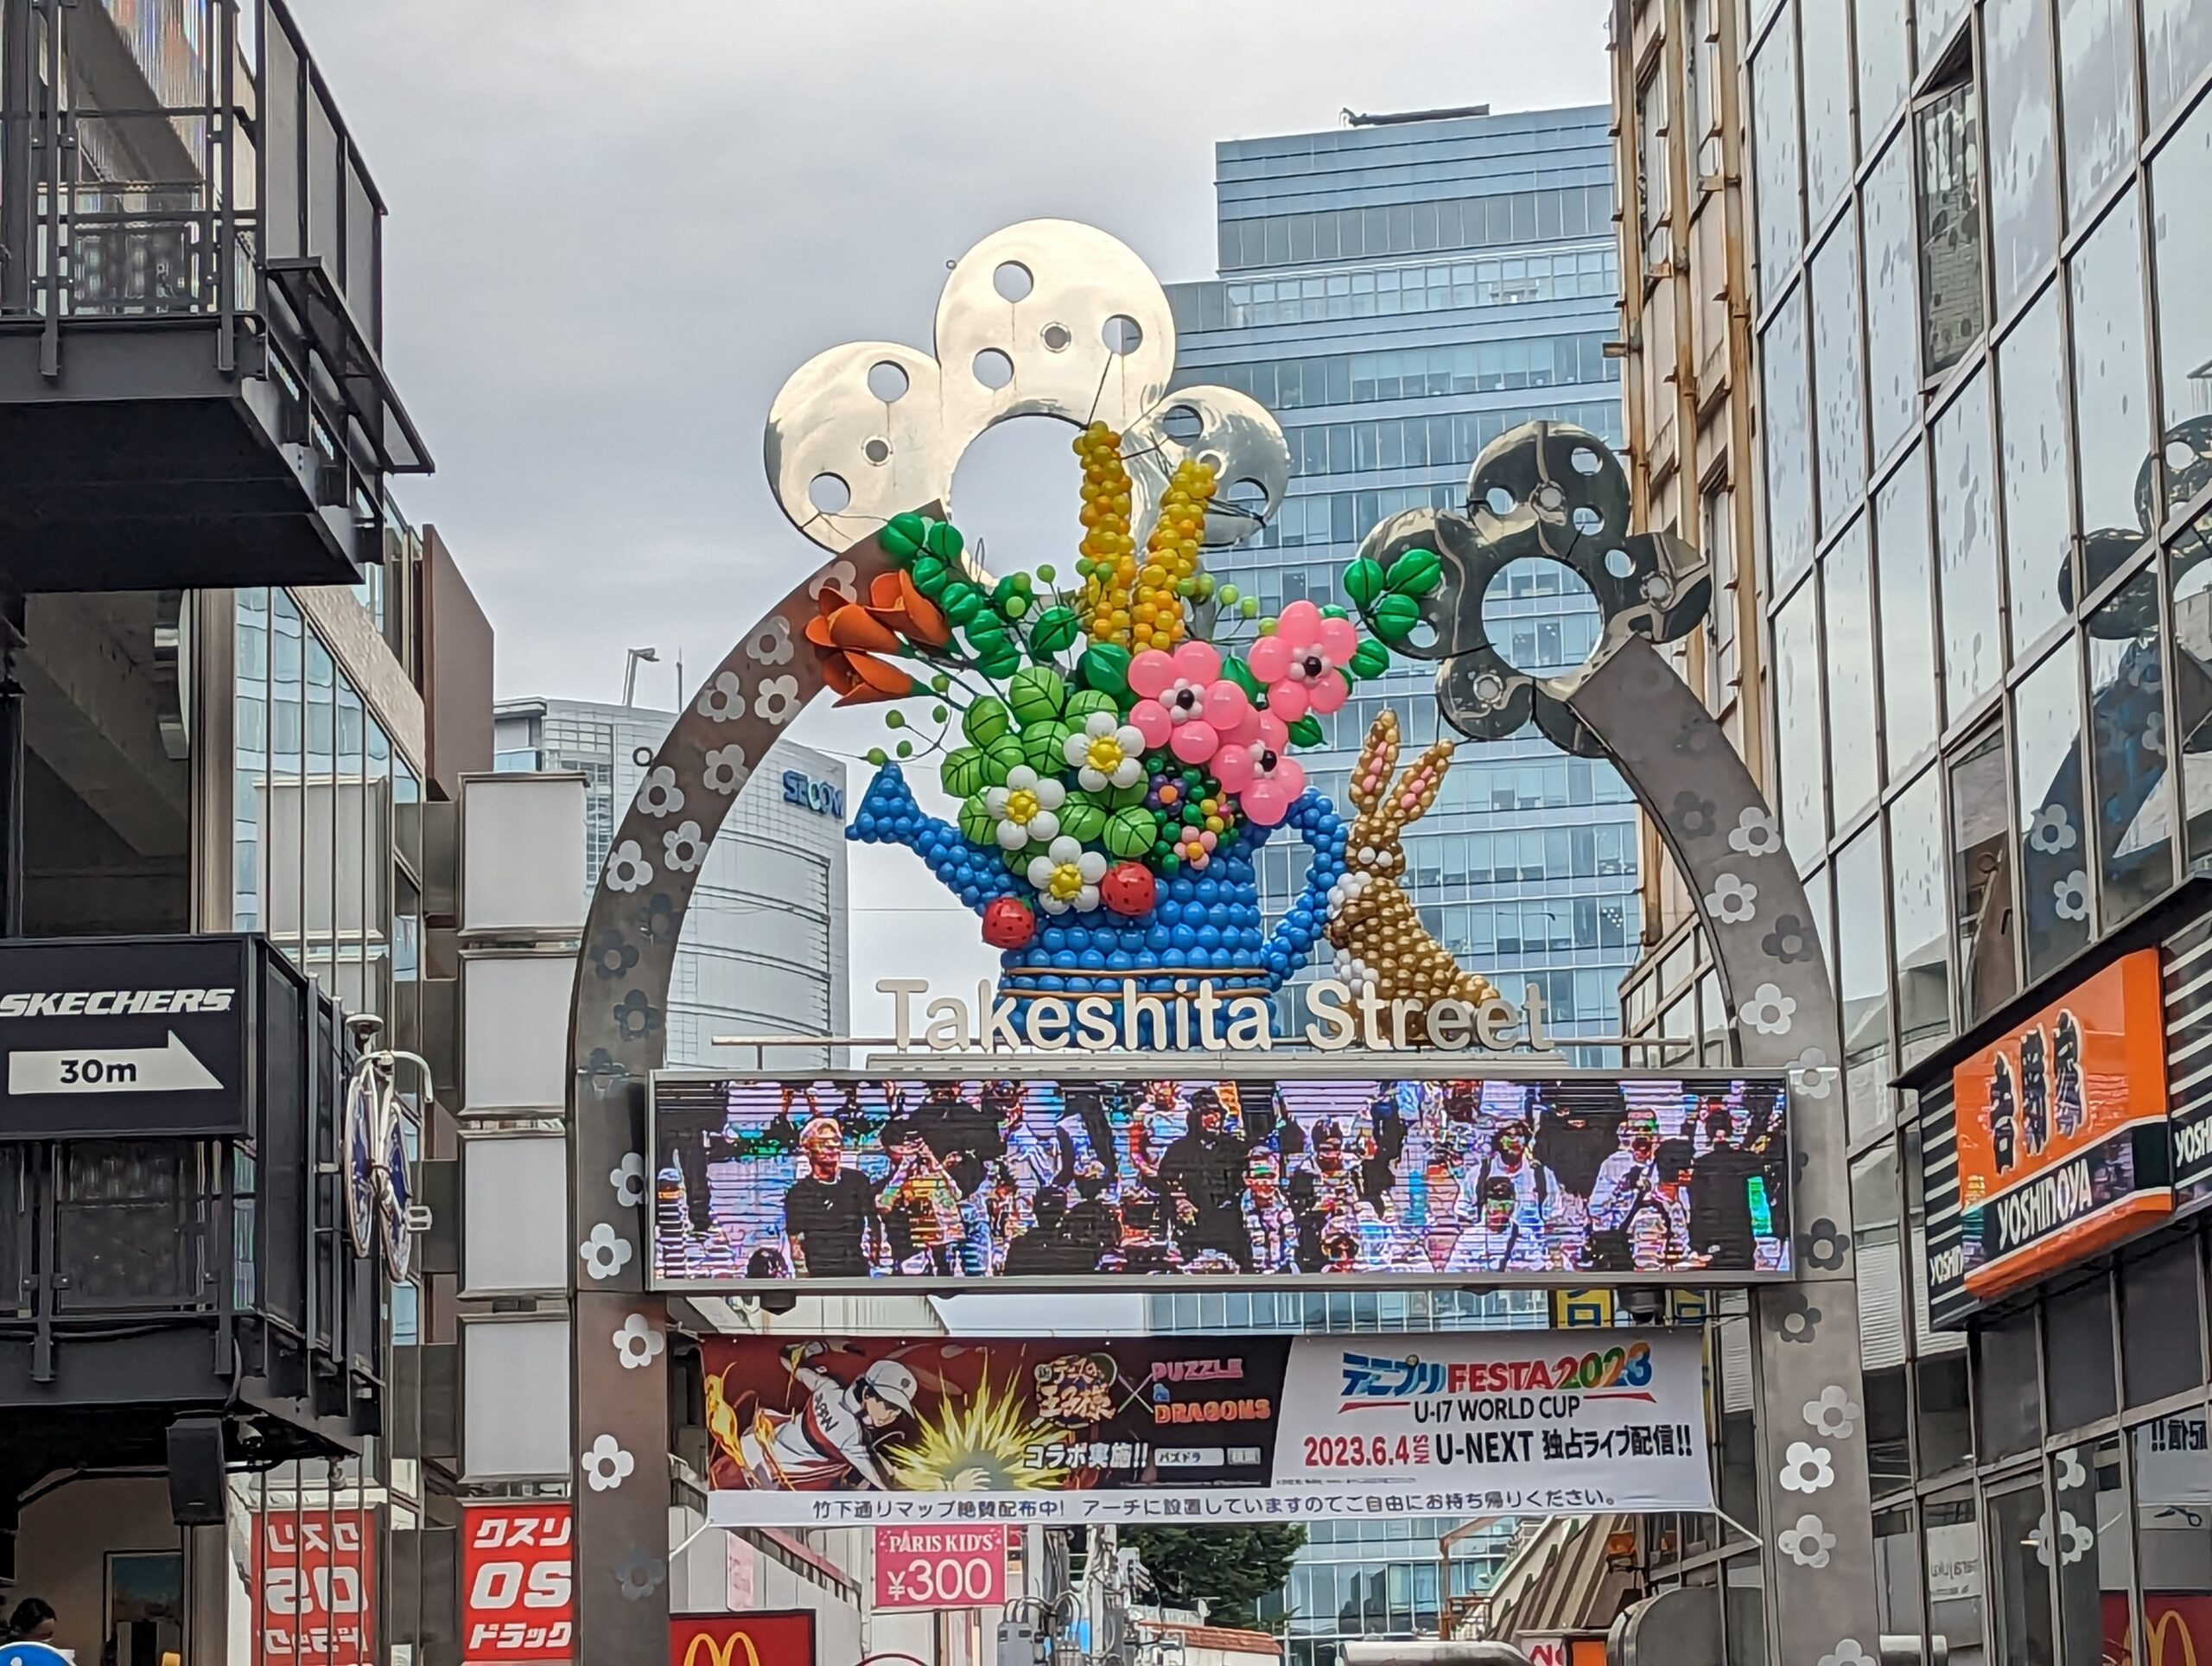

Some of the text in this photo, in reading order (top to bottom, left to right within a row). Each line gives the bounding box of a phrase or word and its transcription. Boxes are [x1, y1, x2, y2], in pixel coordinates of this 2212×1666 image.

[0, 989, 235, 1017] SKECHERS
[876, 978, 1554, 1052] Takeshita Street
[60, 1059, 137, 1084] 30m
[1997, 1159, 2093, 1250] YOSHINOYA
[1457, 1396, 1535, 1421] WORLD
[1538, 1395, 1580, 1418] CUP
[1304, 1435, 1410, 1466] 2023.6.4
[1436, 1430, 1534, 1465] U-NEXT
[473, 1517, 572, 1548] クスリ
[889, 1530, 993, 1553] PARIS KID'S
[470, 1561, 572, 1610] OS
[887, 1558, 993, 1601] ¥300
